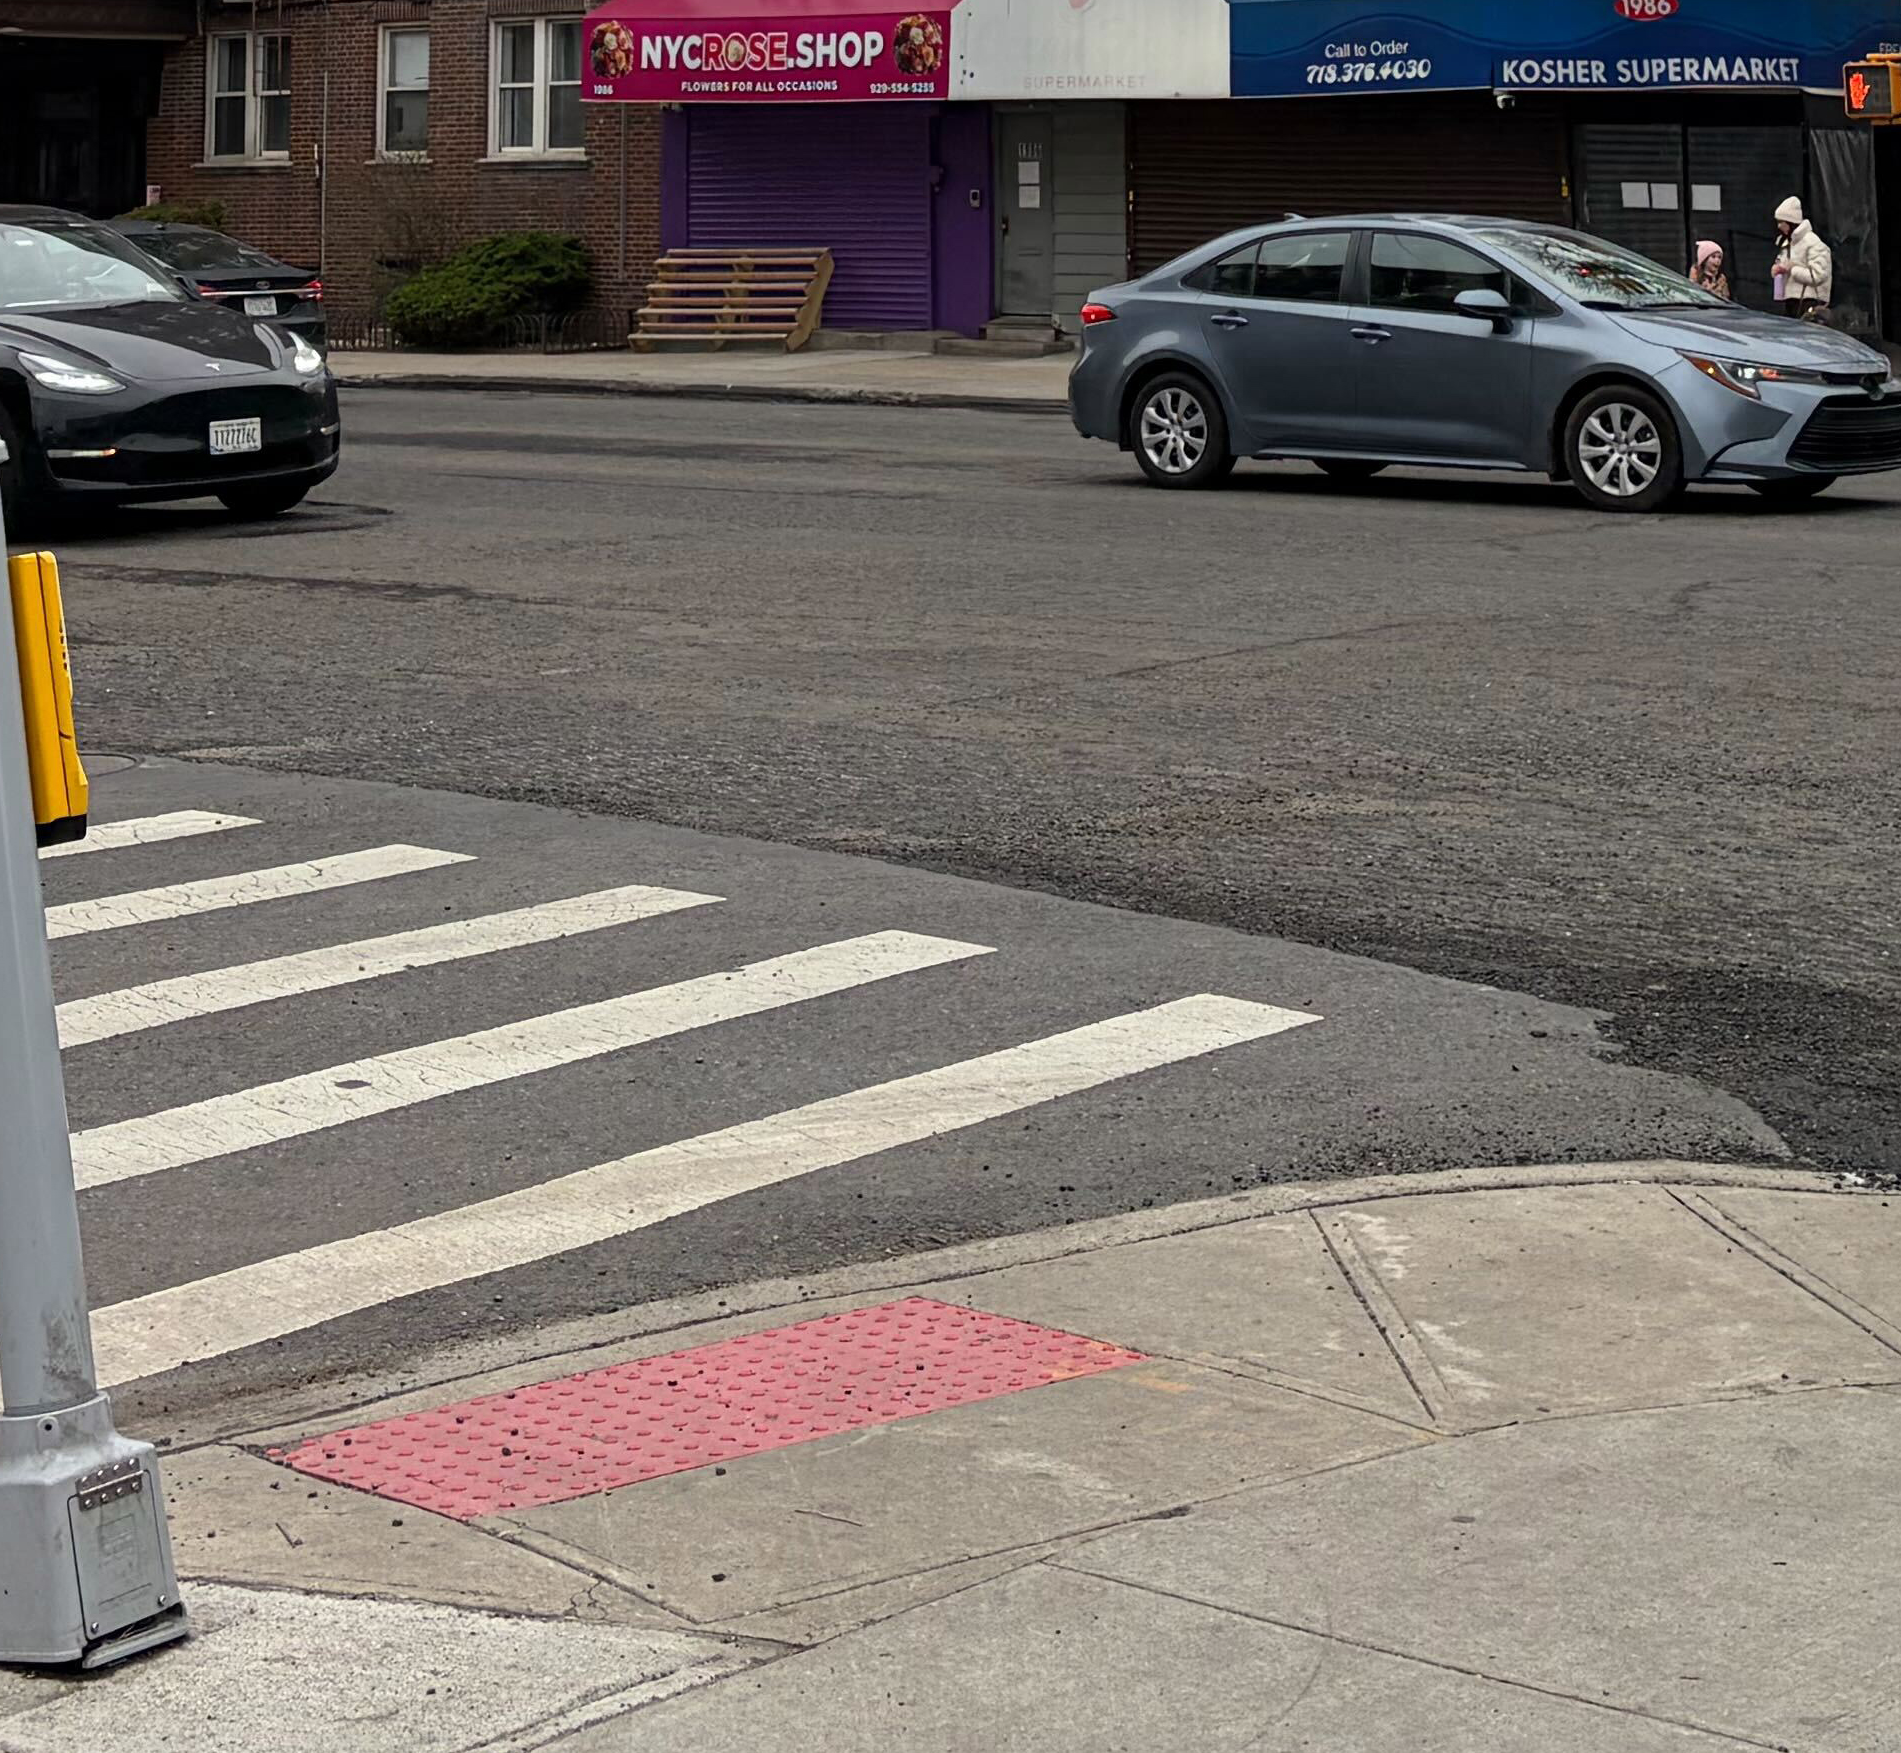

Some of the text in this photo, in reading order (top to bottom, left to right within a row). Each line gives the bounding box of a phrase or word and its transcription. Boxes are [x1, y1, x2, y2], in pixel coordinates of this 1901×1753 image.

[640, 31, 885, 72] NYCROSE.SHOP
[1324, 41, 1408, 59] Call to Order
[1502, 57, 1800, 85] KOSHER SUPERMARKET
[681, 78, 838, 93] FLOWERS FOR ALL OCCASIONS
[1023, 74, 1147, 90] SUPERMARKET
